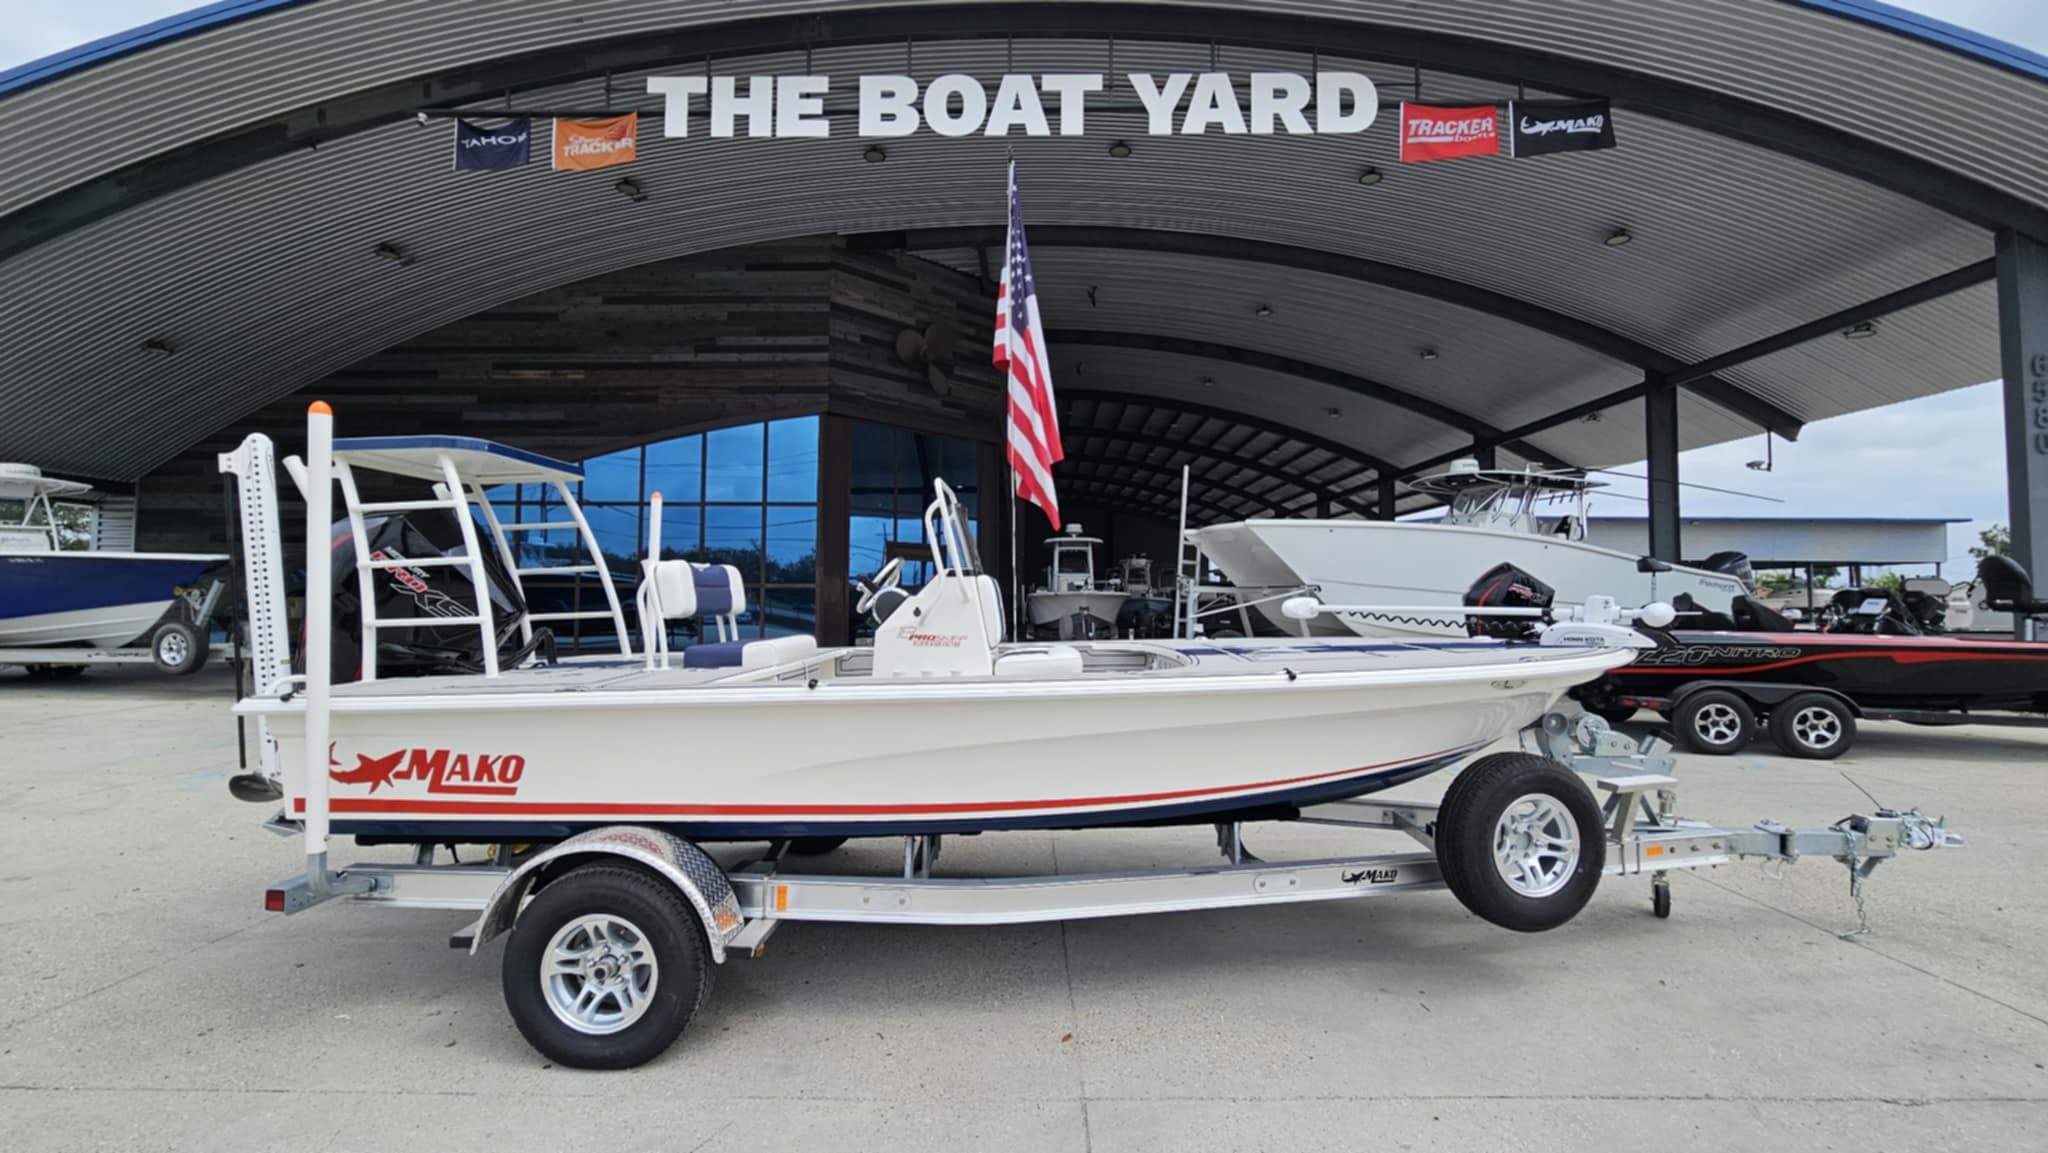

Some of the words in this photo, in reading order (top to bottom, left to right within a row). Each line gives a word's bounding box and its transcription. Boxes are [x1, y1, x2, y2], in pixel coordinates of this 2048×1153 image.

[646, 75, 830, 138] THE
[858, 73, 1104, 137] BOAT
[1127, 71, 1379, 136] YARD
[1407, 116, 1494, 137] TRACKER
[1552, 113, 1605, 134] MAKO
[1709, 646, 1802, 659] NITRO
[392, 748, 526, 796] MAKO
